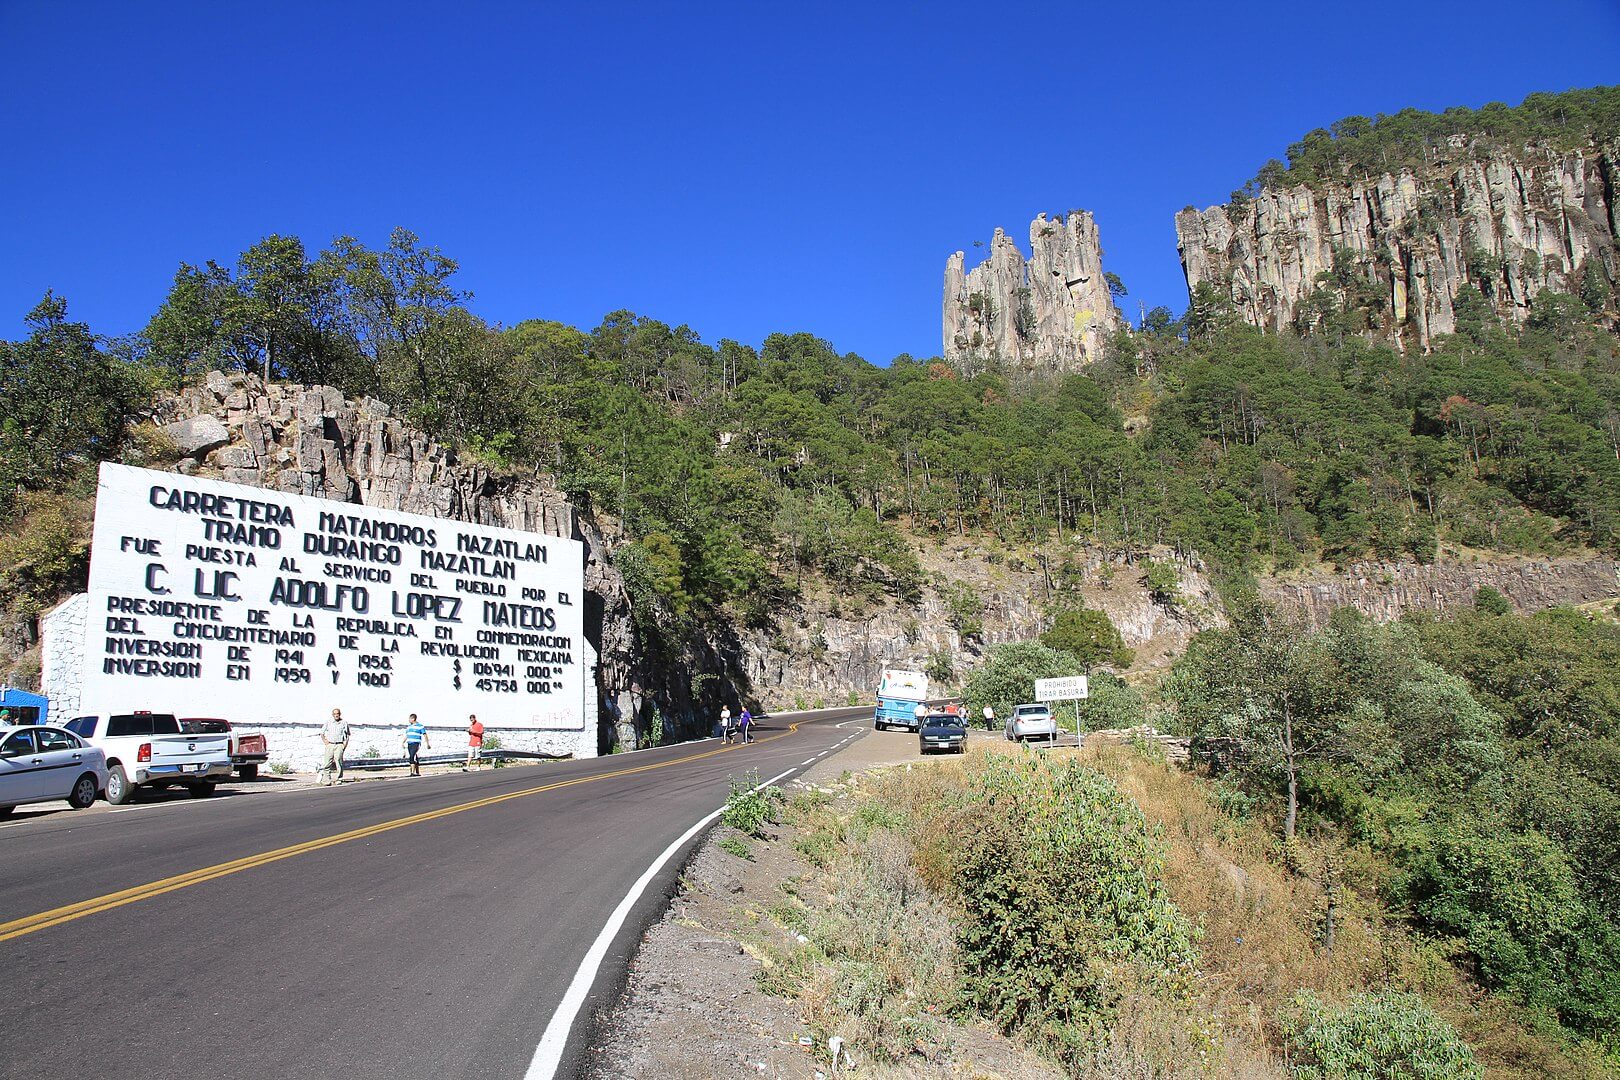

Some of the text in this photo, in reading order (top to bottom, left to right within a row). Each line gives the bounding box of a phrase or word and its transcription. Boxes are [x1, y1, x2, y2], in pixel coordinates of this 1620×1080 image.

[150, 486, 548, 563] CARRETERA MATAMOROS MAZATLAN
[121, 536, 573, 606] FUE PUESTA AL SERVICIO DEL PUEBLO POR EL
[201, 518, 516, 580] TRAMO DURANGO MAZATLAN
[145, 563, 557, 632] C. LIC. ADOLFO LOPEZ MATEOS
[106, 617, 145, 635] DEL
[173, 621, 316, 647] CINCUENTENARIO
[339, 635, 359, 650] DE
[381, 638, 400, 653] LA
[421, 642, 499, 660] REVOLUCION
[107, 596, 222, 622] PRESIDENTE
[247, 609, 270, 625] DE
[293, 613, 315, 629] LA
[435, 626, 452, 640] EN
[477, 630, 571, 649] CONMEMORACION
[103, 658, 201, 678] INVERSION
[227, 665, 250, 680] EN
[274, 668, 311, 683] 1959
[332, 670, 340, 685] Y
[453, 675, 461, 691] $
[105, 637, 202, 659] INVERSION
[228, 646, 251, 662] DE
[275, 649, 303, 665] 1941
[327, 652, 337, 667] A
[453, 659, 461, 674] $
[1039, 688, 1084, 698] TIRAR BASURA
[1044, 680, 1077, 689] PROHIBIDO
